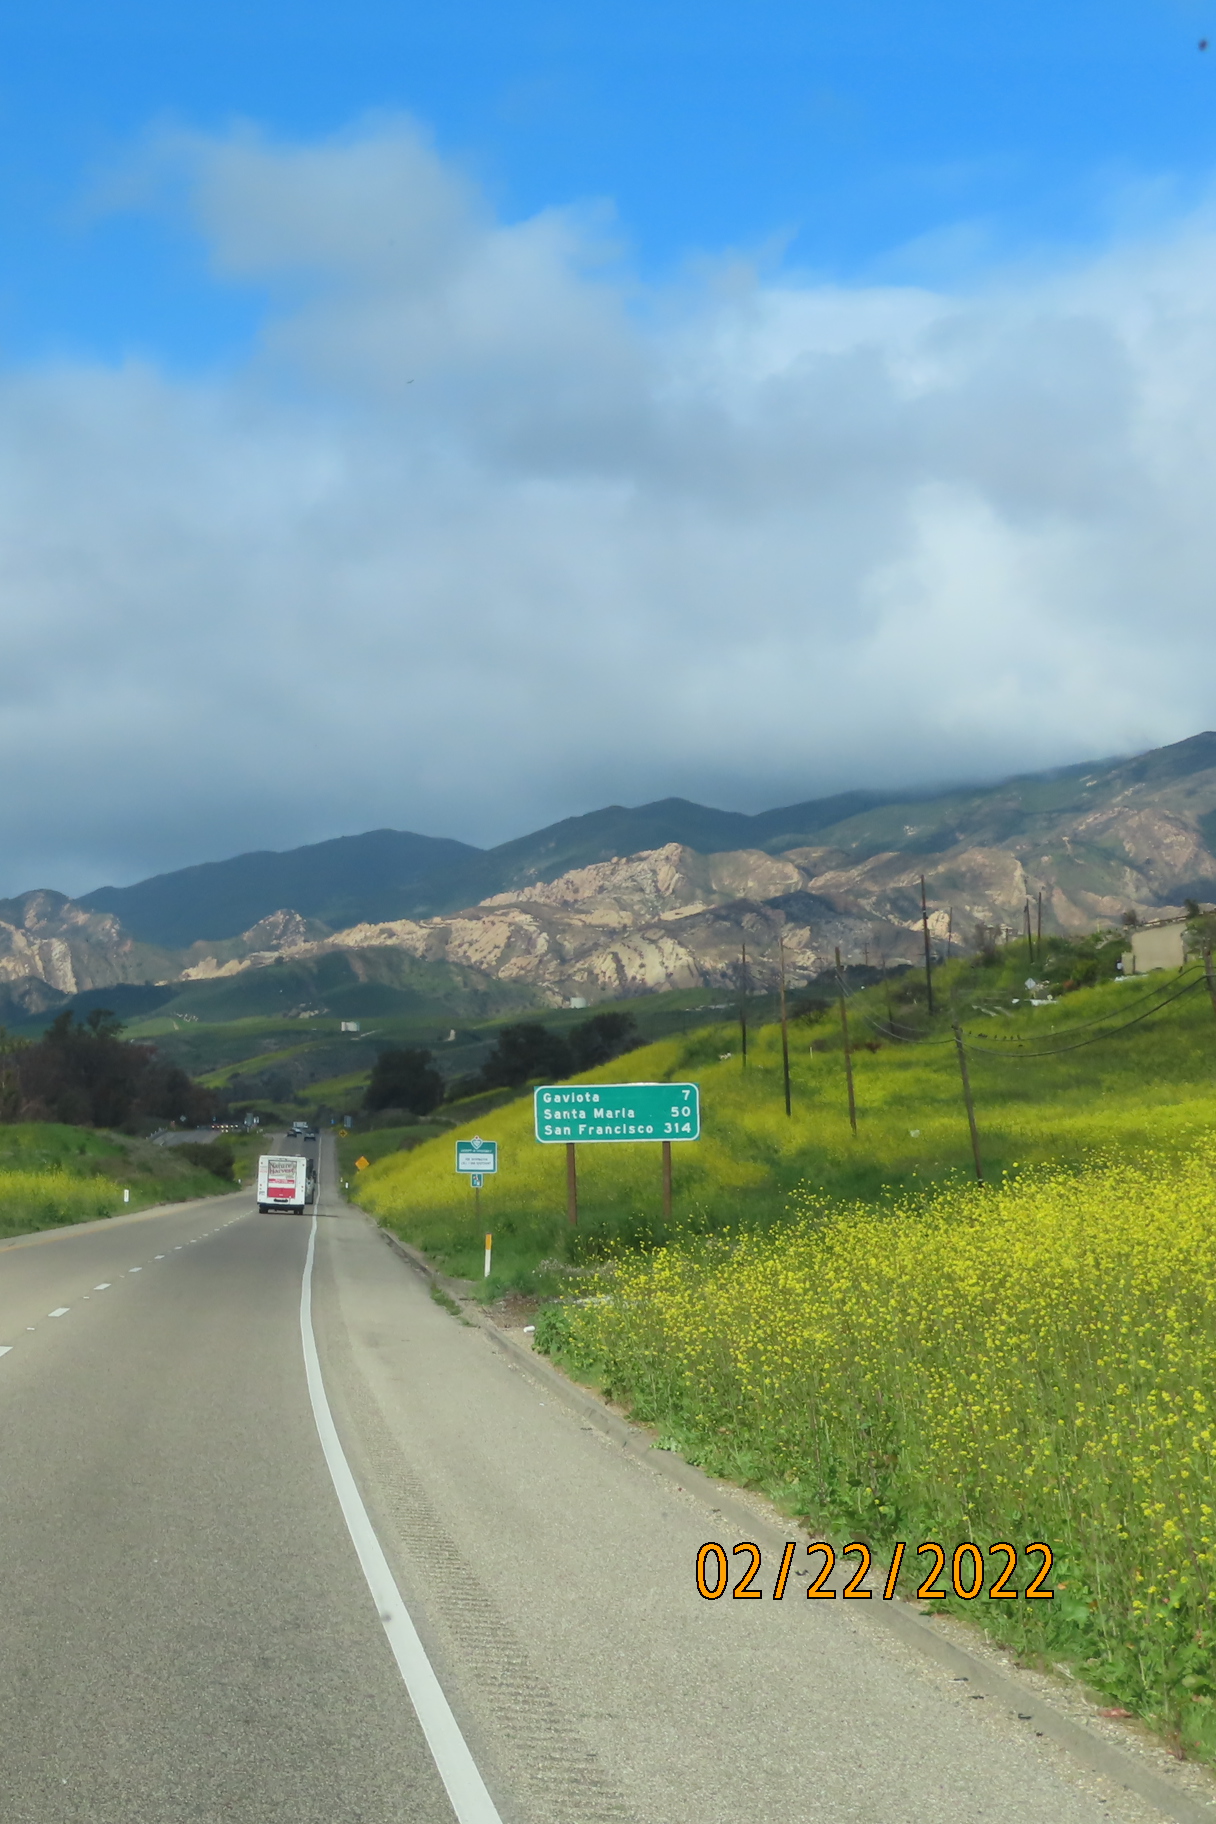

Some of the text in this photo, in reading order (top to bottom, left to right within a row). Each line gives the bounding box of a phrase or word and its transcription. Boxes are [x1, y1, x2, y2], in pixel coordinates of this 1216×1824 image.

[543, 1089, 690, 1103] Gaviota 7
[543, 1106, 691, 1120] Santa Maria 50
[544, 1122, 691, 1136] San Francisco 314
